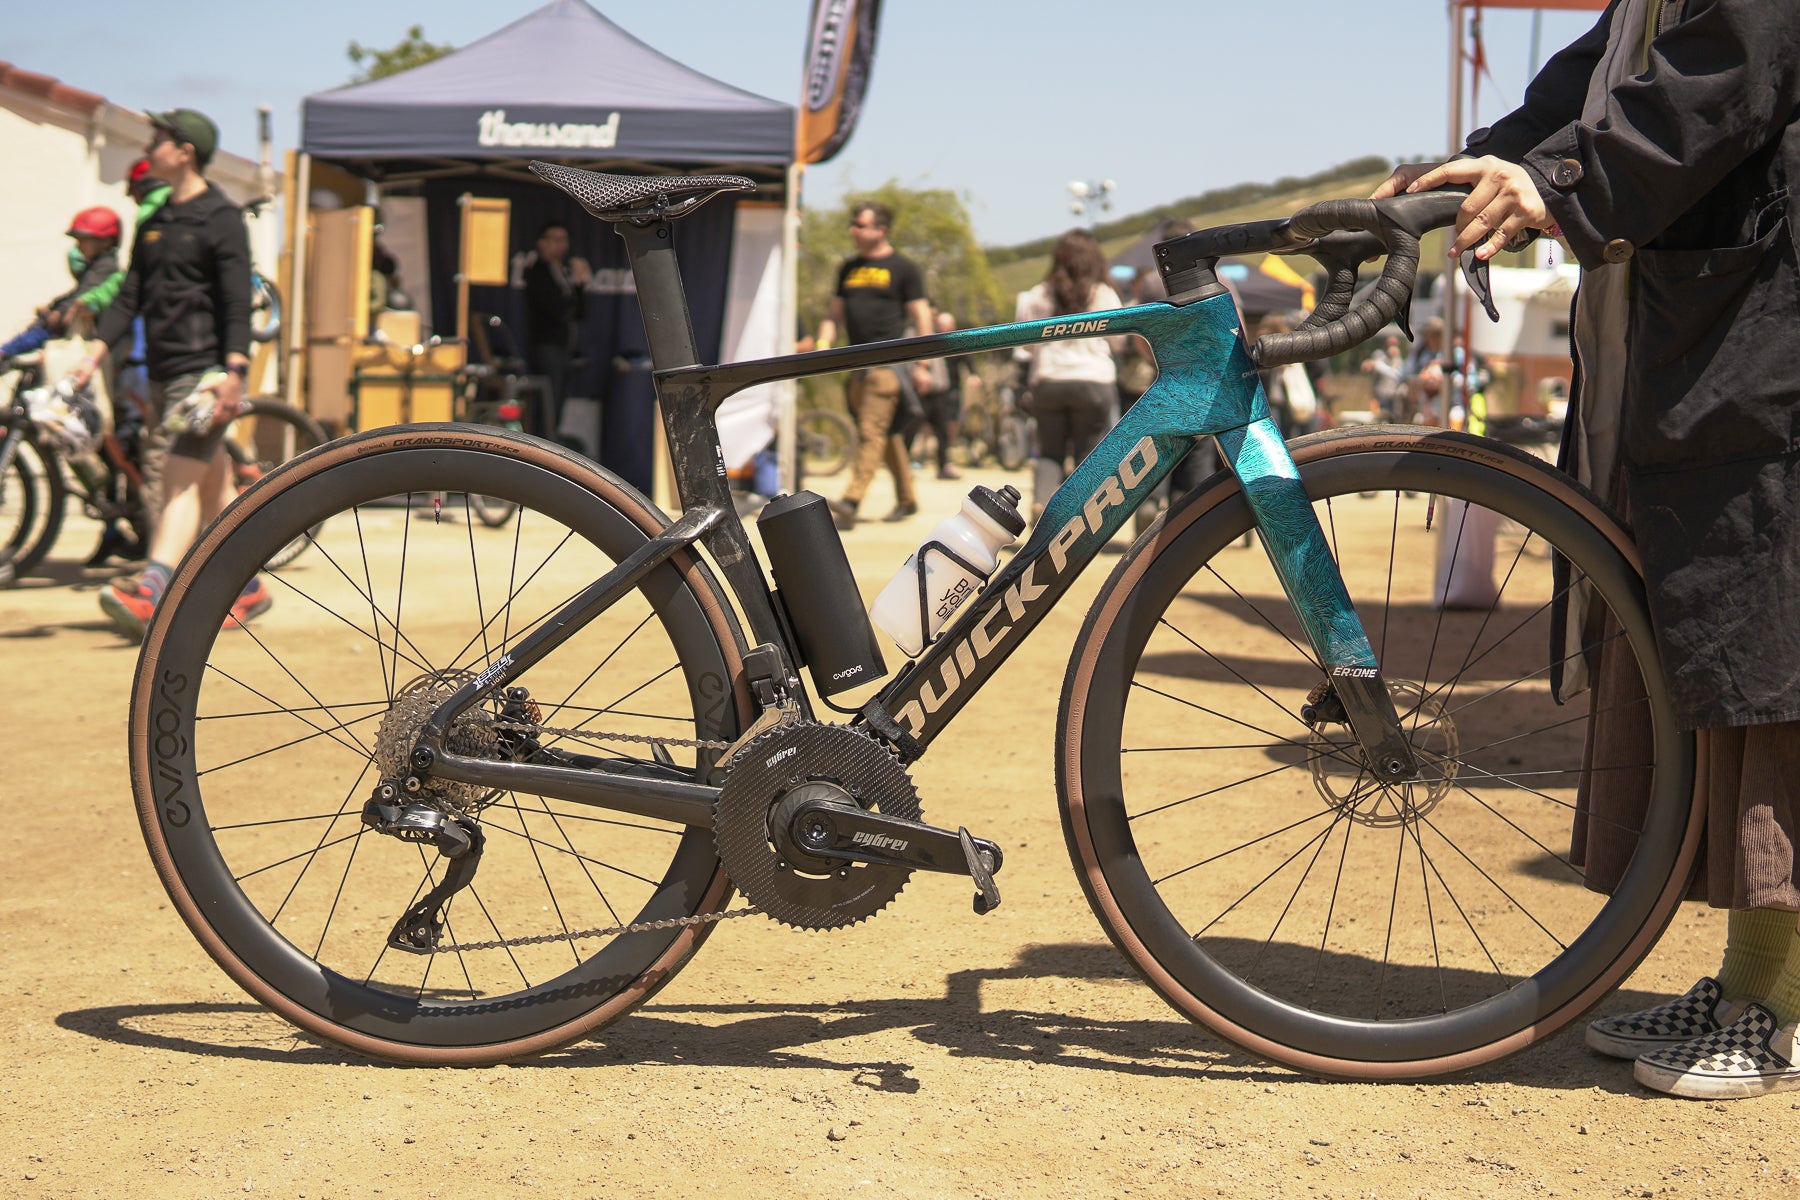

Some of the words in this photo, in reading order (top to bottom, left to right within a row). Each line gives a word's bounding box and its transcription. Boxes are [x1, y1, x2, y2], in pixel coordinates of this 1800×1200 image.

[479, 109, 620, 148] thousand
[1041, 319, 1109, 337] ER:ONE
[393, 437, 494, 449] GRANDSPORT
[1373, 441, 1478, 458] GRANDSPORT
[1049, 436, 1159, 575] PRO
[478, 659, 508, 683] SSL
[1333, 667, 1377, 678] ER:ONE
